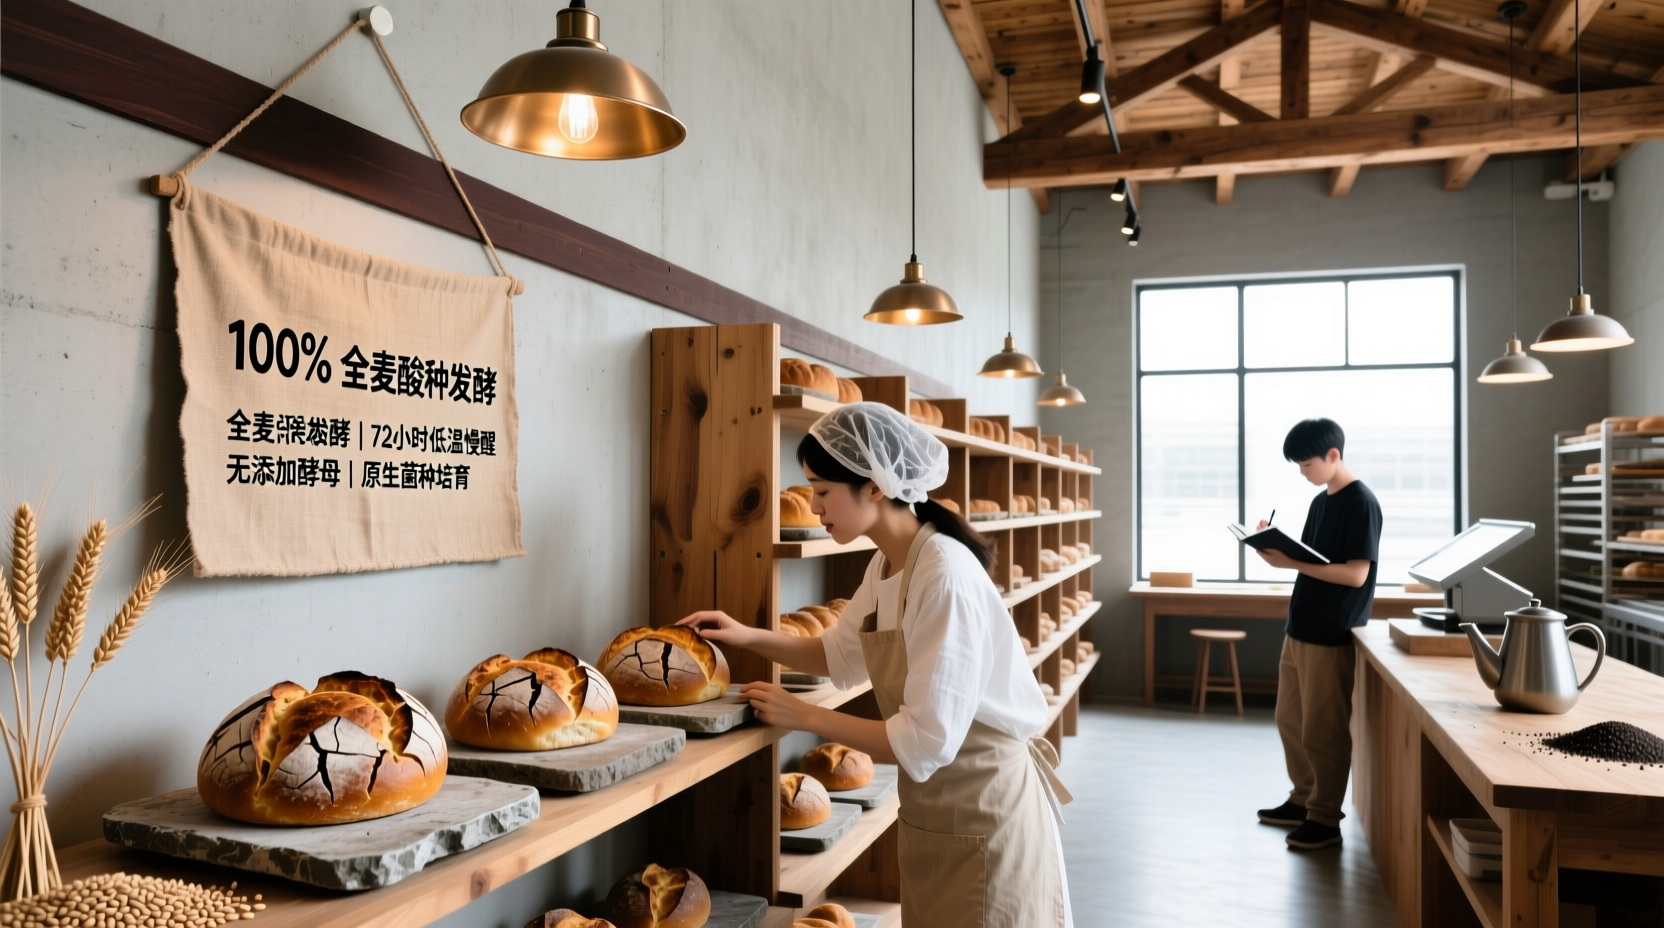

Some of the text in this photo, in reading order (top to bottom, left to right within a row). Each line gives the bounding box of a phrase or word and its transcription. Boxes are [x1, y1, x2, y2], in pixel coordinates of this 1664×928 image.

[228, 319, 498, 406] 100% 全麦酸种发酵
[226, 454, 342, 488] 无添加酵母
[361, 460, 471, 490] 原生菌种培育
